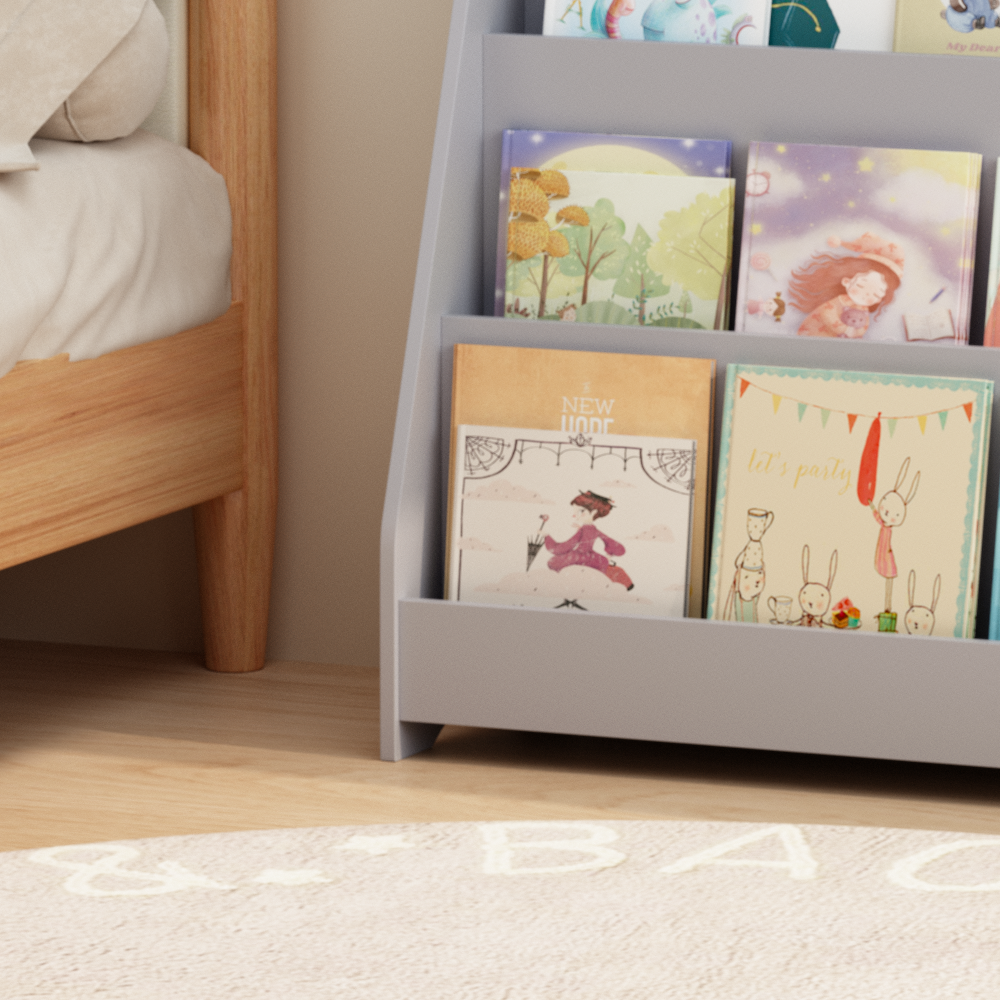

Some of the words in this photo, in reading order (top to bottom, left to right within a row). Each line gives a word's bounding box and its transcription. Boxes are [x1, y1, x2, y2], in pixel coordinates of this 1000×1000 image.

[946, 42, 967, 53] My
[562, 396, 615, 415] NEW
[793, 455, 853, 496] party
[28, 843, 236, 896] &
